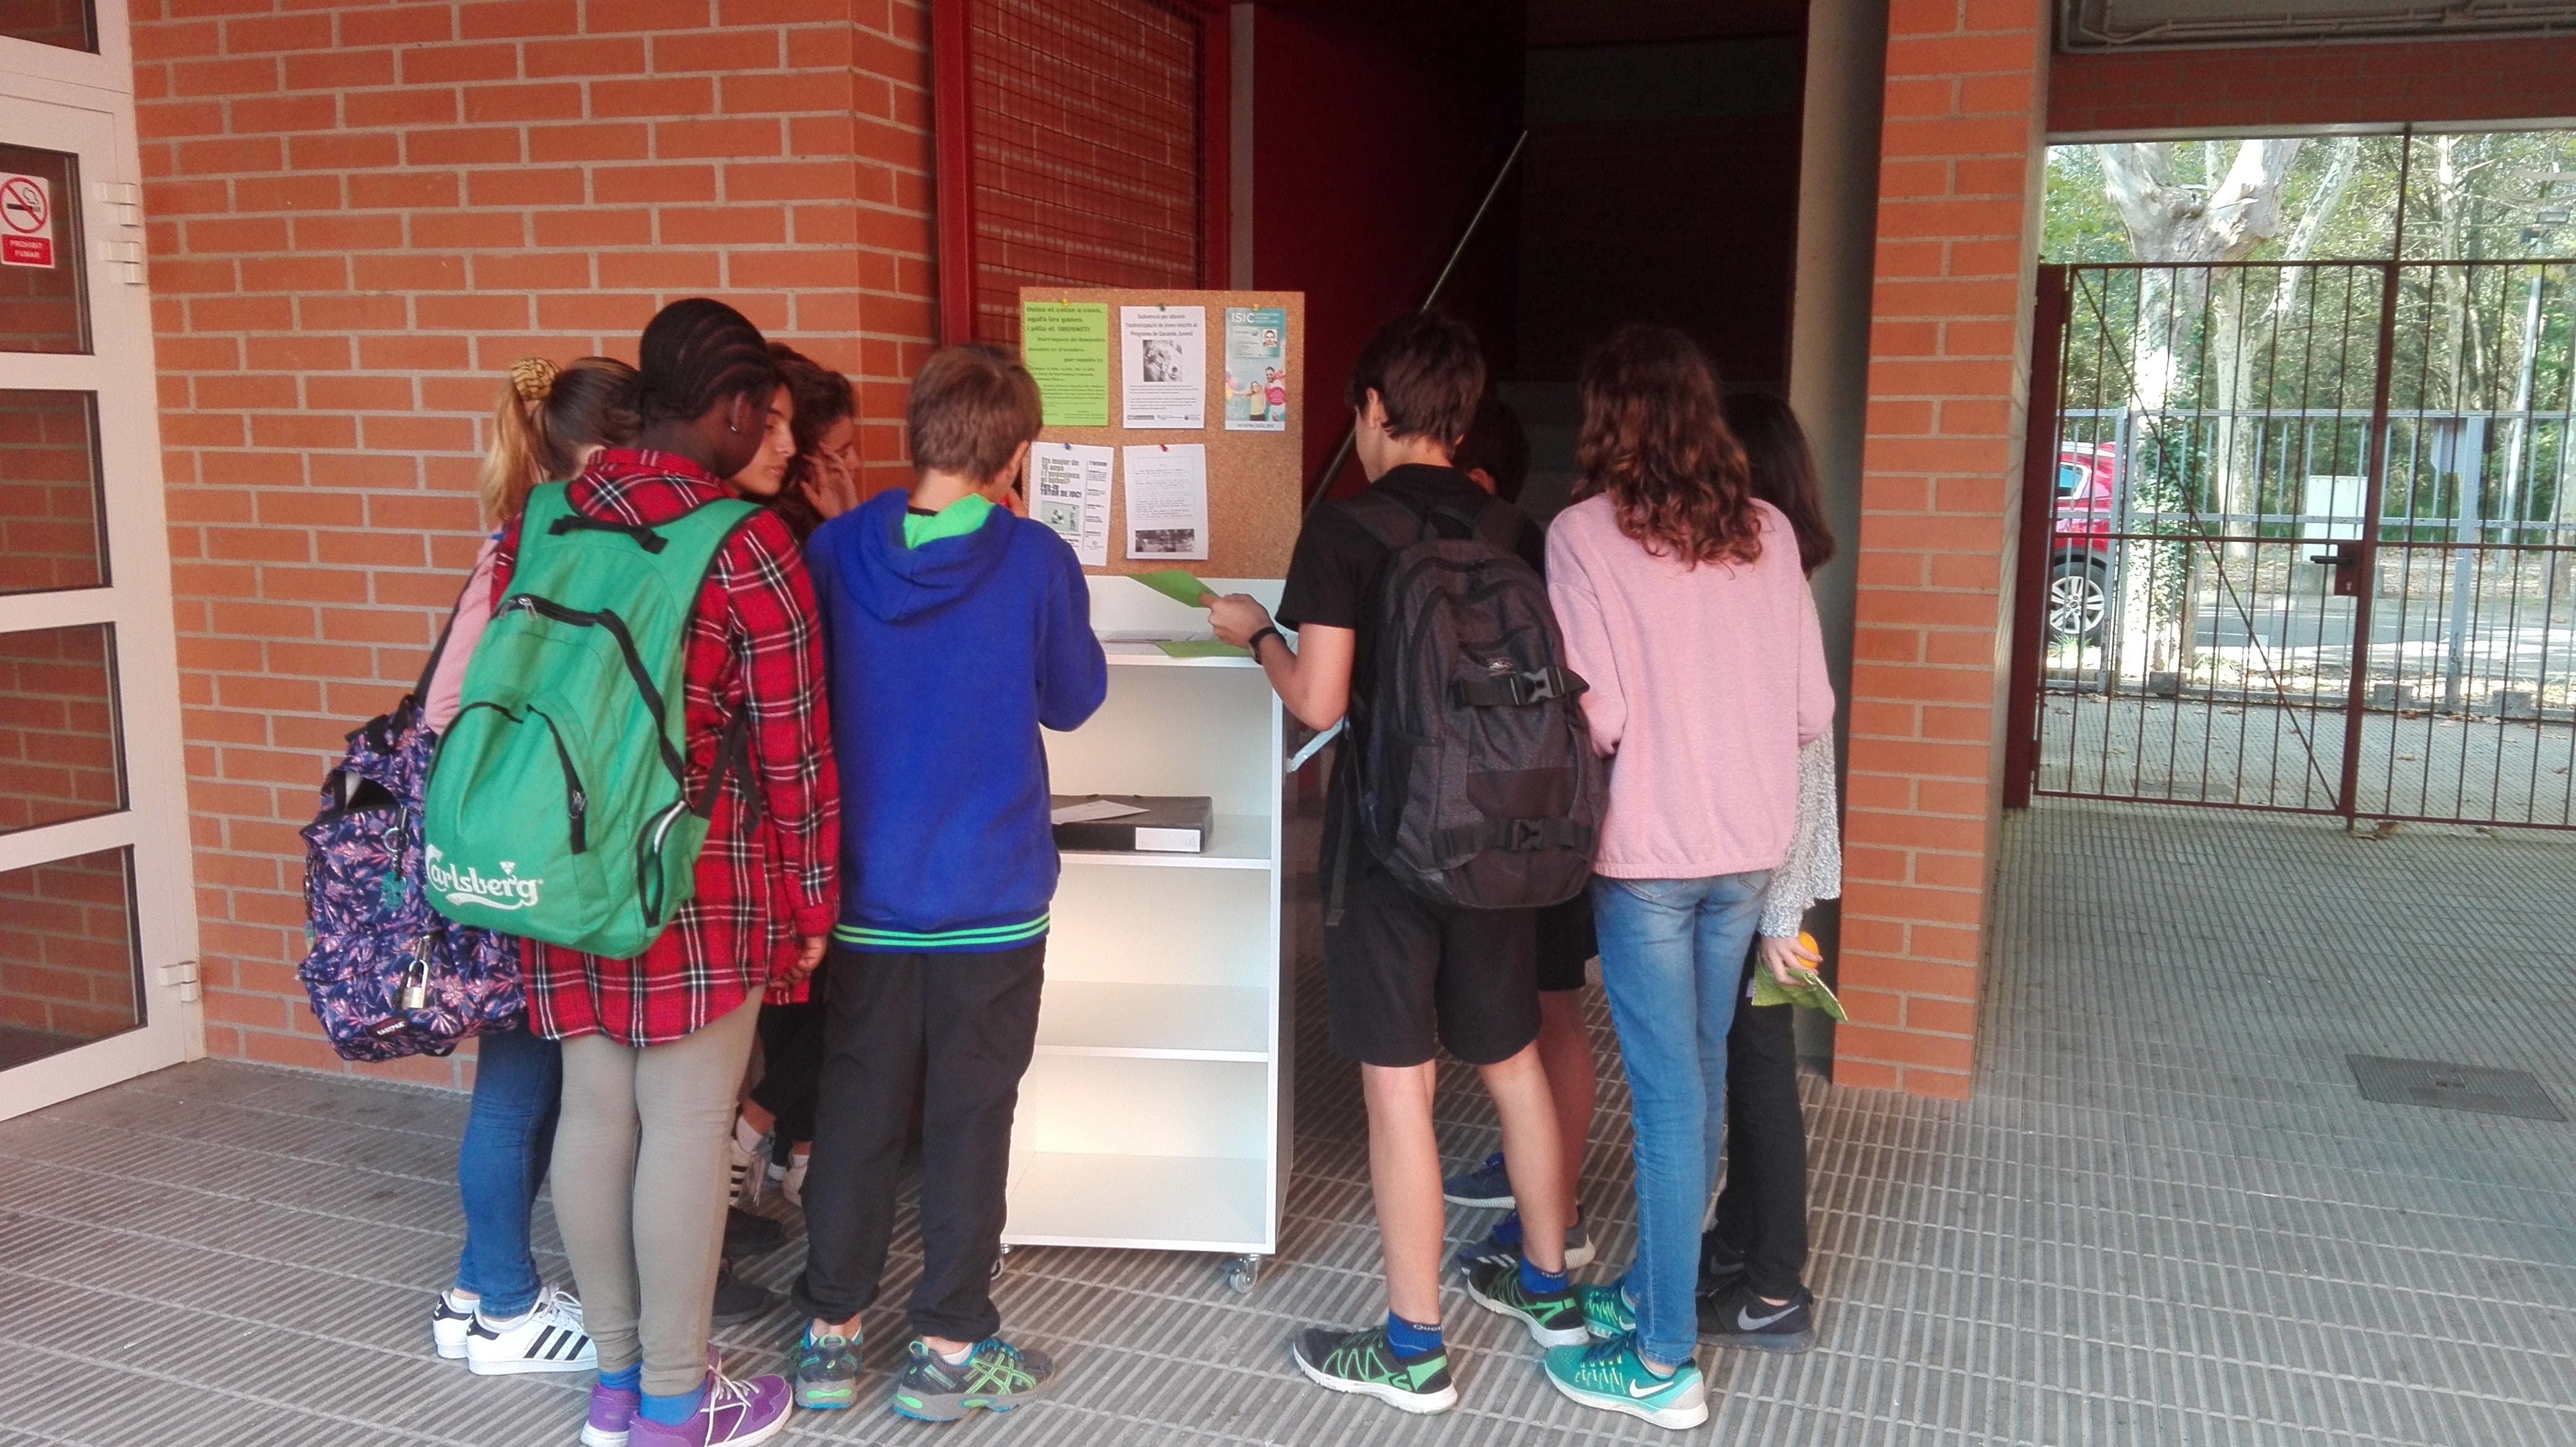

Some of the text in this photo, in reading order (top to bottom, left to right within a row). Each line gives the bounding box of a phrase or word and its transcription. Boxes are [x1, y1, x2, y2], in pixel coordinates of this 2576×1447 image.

[1231, 313, 1255, 323] ISIC
[425, 844, 539, 910] Carlsberg
[376, 1021, 405, 1036] EASTPAK
